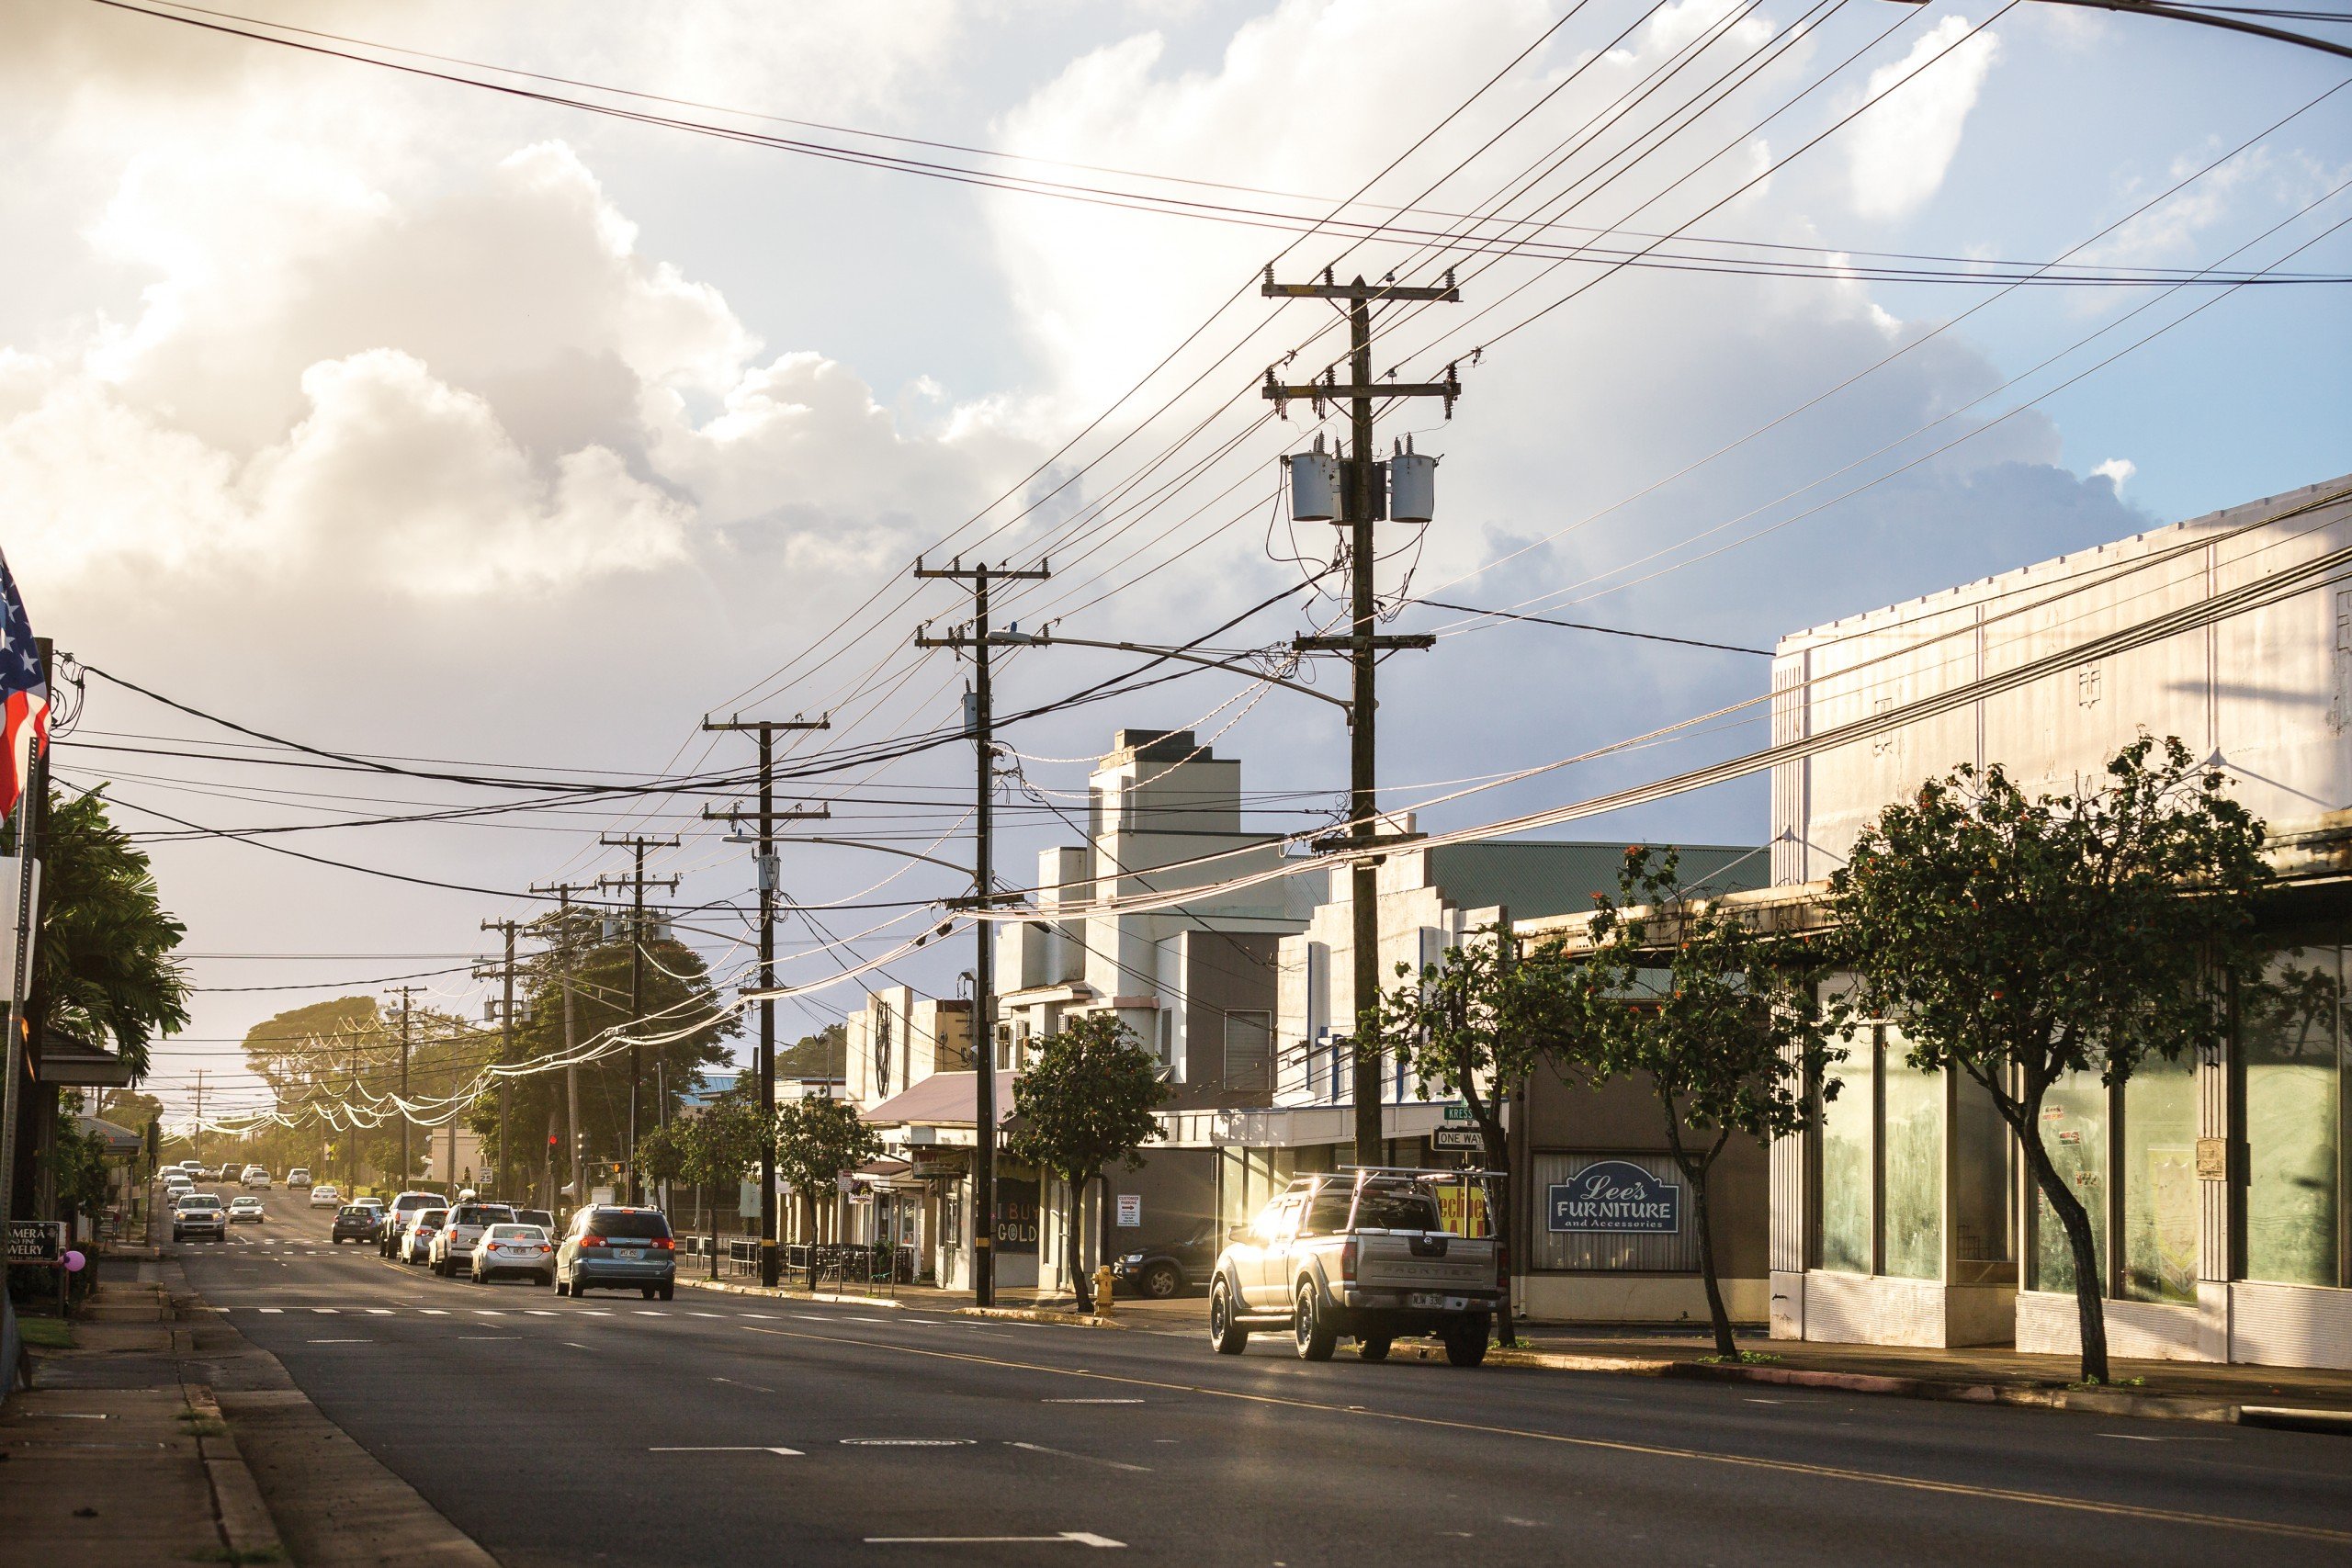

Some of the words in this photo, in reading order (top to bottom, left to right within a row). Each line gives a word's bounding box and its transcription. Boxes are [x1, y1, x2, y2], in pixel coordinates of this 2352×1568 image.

[1449, 1109, 1473, 1119] KRESS
[1441, 1134, 1460, 1143] ONE
[1580, 1176, 1647, 1200] Lee's
[1557, 1201, 1671, 1219] FURNITURE
[1591, 1219, 1663, 1228] Accessories
[998, 1224, 1037, 1242] GOLD
